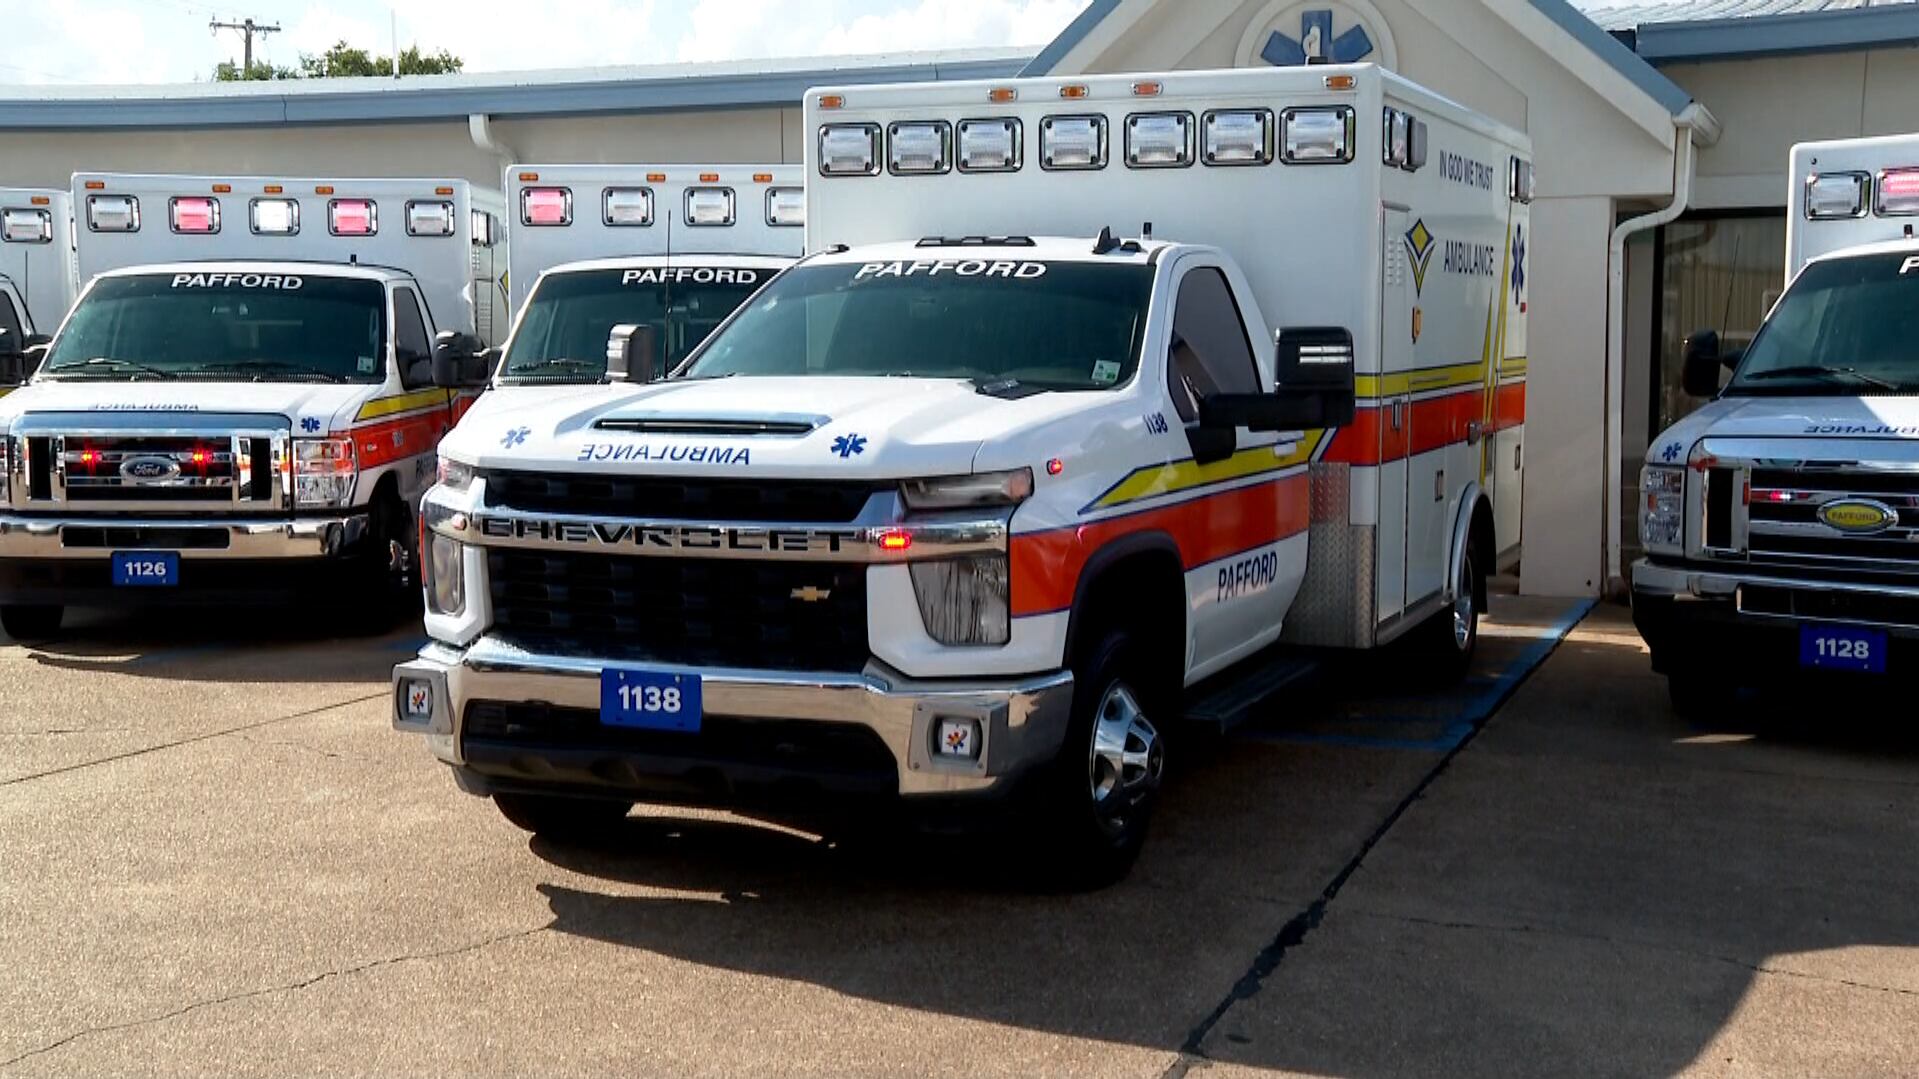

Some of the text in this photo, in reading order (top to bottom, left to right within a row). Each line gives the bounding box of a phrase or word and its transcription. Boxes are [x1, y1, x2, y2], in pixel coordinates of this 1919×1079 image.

[1439, 150, 1493, 191] IN GOD WE TRUST
[1444, 240, 1494, 276] AMBULANCE
[171, 273, 303, 289] PAFFORD
[622, 268, 757, 285] PAFFORD
[854, 260, 1048, 280] PAFFORD
[1143, 412, 1168, 435] 1138
[134, 463, 161, 476] Ford
[481, 517, 858, 552] CHEVROLET
[125, 561, 167, 576] 1126
[1217, 550, 1277, 603] PAFFORD
[1815, 637, 1870, 659] 1128
[618, 684, 681, 713] 1138
